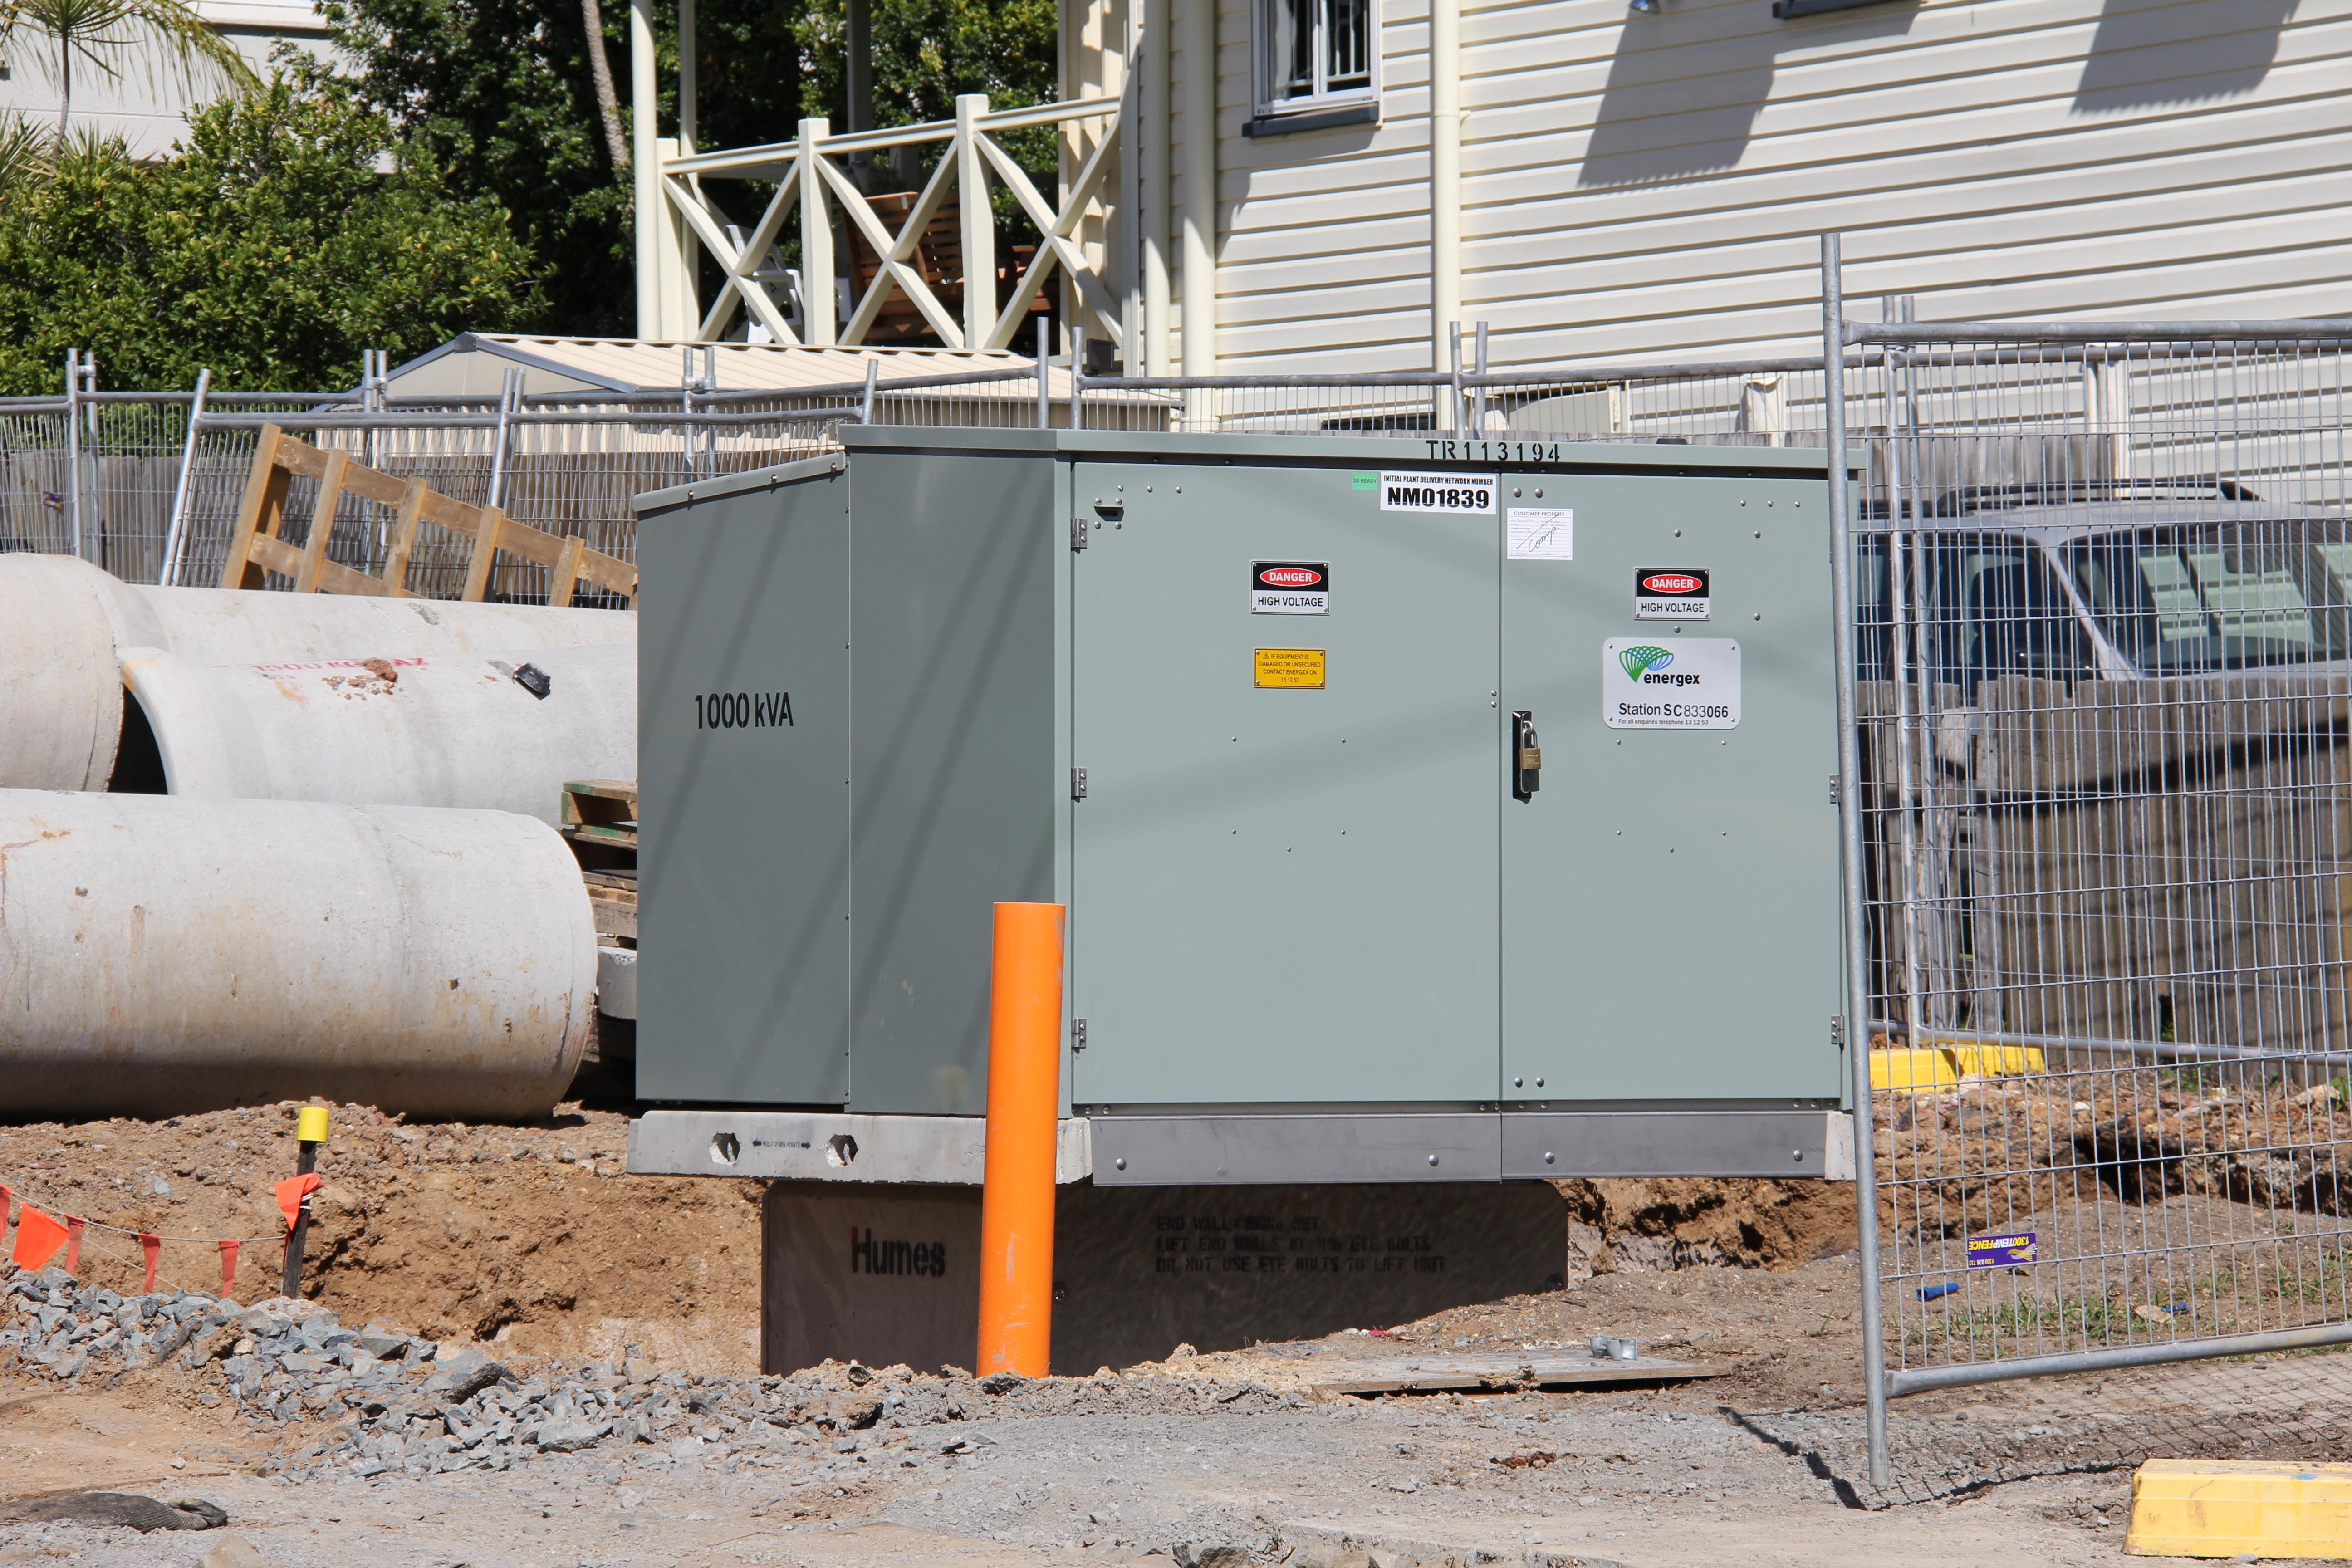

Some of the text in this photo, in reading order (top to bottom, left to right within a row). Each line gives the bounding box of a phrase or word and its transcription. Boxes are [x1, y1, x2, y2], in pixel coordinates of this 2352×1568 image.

[1426, 440, 1560, 462] TR113194
[1388, 487, 1489, 509] NM01839
[1269, 572, 1312, 582] DANGER
[1652, 579, 1694, 588] DANGER
[1258, 597, 1323, 607] HIGH VOLTAGE
[1641, 603, 1704, 612] HIGH VOLTAGE
[1644, 674, 1700, 687] energex
[695, 692, 794, 729] 1000 kVA
[1619, 703, 1661, 715] Station
[1157, 1216, 1185, 1231] END
[1293, 1216, 1320, 1231] NET
[1156, 1235, 1189, 1252] LIFT
[1199, 1236, 1226, 1252] END
[851, 1226, 946, 1278] Humes
[1186, 1256, 1213, 1272] NOT
[1222, 1256, 1250, 1272] USE
